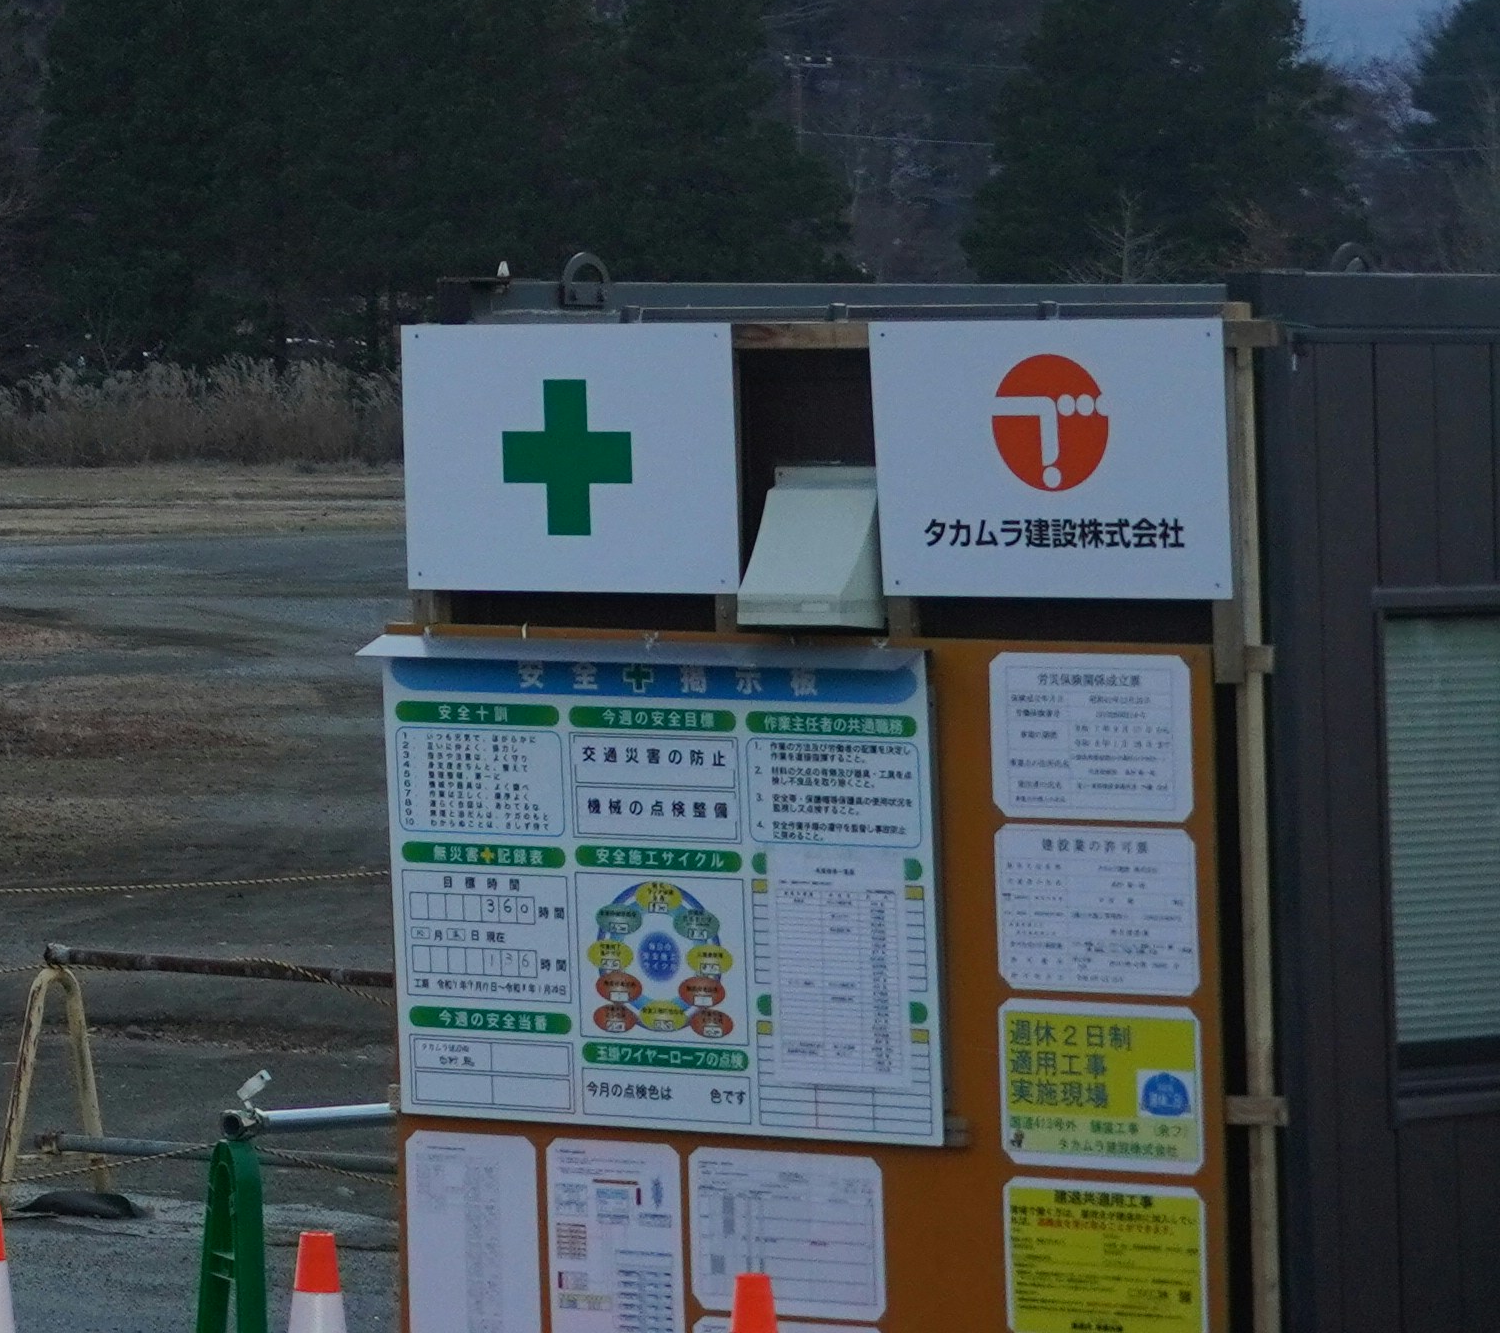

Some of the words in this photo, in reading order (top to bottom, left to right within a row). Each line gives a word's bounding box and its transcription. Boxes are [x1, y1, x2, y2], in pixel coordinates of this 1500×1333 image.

[924, 517, 1186, 550] タカムラ建設株式会社
[518, 660, 598, 690] 安全
[680, 665, 818, 696] 掲示板
[438, 704, 509, 722] 安全十訓
[602, 709, 715, 728] 今週の安全目標
[764, 716, 904, 735] 作業主任者の共通職務
[582, 745, 726, 767] 交通災害の防止
[587, 797, 729, 818] 機械の点検整備
[433, 845, 479, 862] 無災害
[497, 847, 544, 865] 記録表
[1041, 837, 1149, 854] 建設業の許可票
[596, 848, 725, 867] 安全施工サイクル
[443, 876, 520, 892] 目標時間
[486, 898, 528, 914] 360
[538, 906, 565, 919] 時間
[540, 958, 567, 972] 時間
[438, 1009, 548, 1031] 今週の安全当番
[596, 1046, 744, 1068] 玉掛ワイヤーロープの点検
[1010, 1048, 1108, 1079] 適用工事
[586, 1081, 673, 1101] 今月の点検色は
[709, 1088, 747, 1105] 色です
[1011, 1078, 1110, 1108] 実施現場
